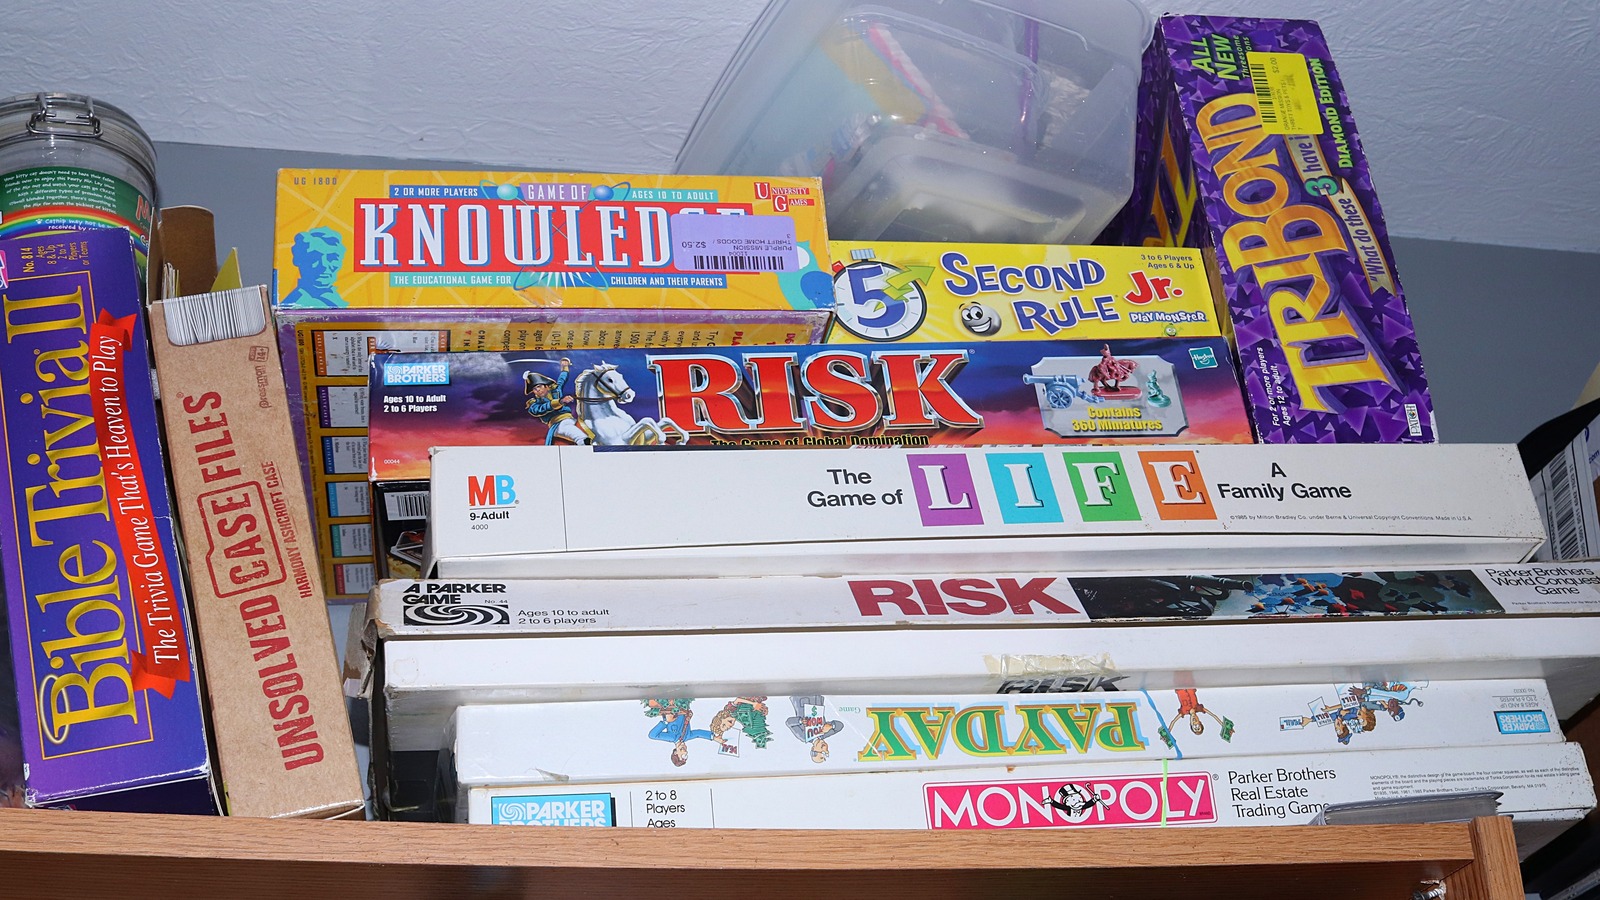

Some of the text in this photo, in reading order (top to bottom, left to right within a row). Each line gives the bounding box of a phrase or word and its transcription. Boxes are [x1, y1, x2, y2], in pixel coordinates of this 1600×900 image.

[1191, 37, 1215, 74] ALL
[1211, 34, 1240, 80] NEW
[1233, 35, 1250, 79] Threesome
[1270, 57, 1279, 74] $2.00
[1309, 58, 1353, 168] DIAMOND EDITION
[1298, 141, 1323, 173] have
[293, 177, 306, 185] UG
[1304, 175, 1340, 197] 3
[394, 187, 478, 197] 2 OR MORE PLAYERS
[527, 184, 587, 200] GAME OF
[632, 190, 714, 201] AGES 10 TO ADULT
[755, 182, 808, 199] UNIVERSITY
[774, 196, 808, 212] GAMES
[1338, 198, 1364, 227] these
[359, 203, 746, 268] KNOWLED
[1353, 229, 1372, 243] do
[36, 246, 48, 258] Ages
[68, 242, 80, 261] Players
[79, 241, 89, 258] Teams
[681, 241, 707, 249] $2.50
[1196, 93, 1391, 412] TRIBOND
[20, 247, 35, 273] No. 814
[1147, 262, 1168, 270] Ages
[1164, 254, 1193, 262] Players
[394, 275, 512, 285] THE EDUCATIONAL GAME FOR
[610, 276, 723, 287] CHILDREN AND THEIR PARENTS
[940, 252, 1105, 296] SECOND
[1124, 271, 1183, 304] Jr.
[847, 265, 900, 328] 5
[3, 285, 87, 344] II
[1013, 295, 1118, 336] RULE
[402, 365, 446, 374] PARKER
[387, 373, 447, 383] BROTHERS
[646, 349, 985, 436] RISK
[1257, 346, 1281, 427] For 2 or more players
[383, 394, 447, 403] Ages 10 to Adult
[1271, 365, 1291, 427] Ages 12 to adult
[408, 405, 438, 413] Players
[1086, 406, 1142, 418] Contains
[1071, 419, 1163, 432] 360 Miniatures
[20, 340, 110, 547] Trivia
[182, 391, 242, 484] FILES
[804, 436, 847, 446] Global
[850, 434, 930, 446] Domination
[827, 469, 873, 485] The
[1270, 462, 1287, 478] A
[467, 474, 516, 508] MB
[807, 488, 904, 507] Game of
[1217, 483, 1353, 502] Family Game
[91, 335, 182, 665] The Trivia Game That's Heaven to Play
[469, 510, 510, 521] 9-Adult
[260, 460, 313, 599] HARMONY ASHCROFT CASE
[210, 492, 270, 585] CASE
[1484, 567, 1595, 578] Parker Brothers
[403, 583, 507, 594] A PARKER
[1491, 576, 1600, 587] World Conquest
[847, 577, 1081, 617] RISK
[1534, 586, 1580, 595] Game
[402, 594, 462, 605] GAME
[518, 610, 549, 618] Ages
[581, 608, 610, 616] adult
[554, 616, 597, 625] players
[35, 540, 138, 738] Bible
[239, 594, 325, 770] UNSOLVED
[839, 706, 861, 714] Game
[1498, 713, 1544, 723] BROTHERS
[806, 726, 824, 738] YOU
[1502, 721, 1536, 732] PARKER
[1228, 767, 1337, 784] Parker Brothers
[645, 790, 678, 800] 2 to 8
[1231, 786, 1309, 801] Real Estate
[526, 800, 606, 819] PARKER
[646, 803, 686, 815] Players
[934, 779, 1206, 829] MONOPOLY
[1232, 803, 1286, 819] Trading
